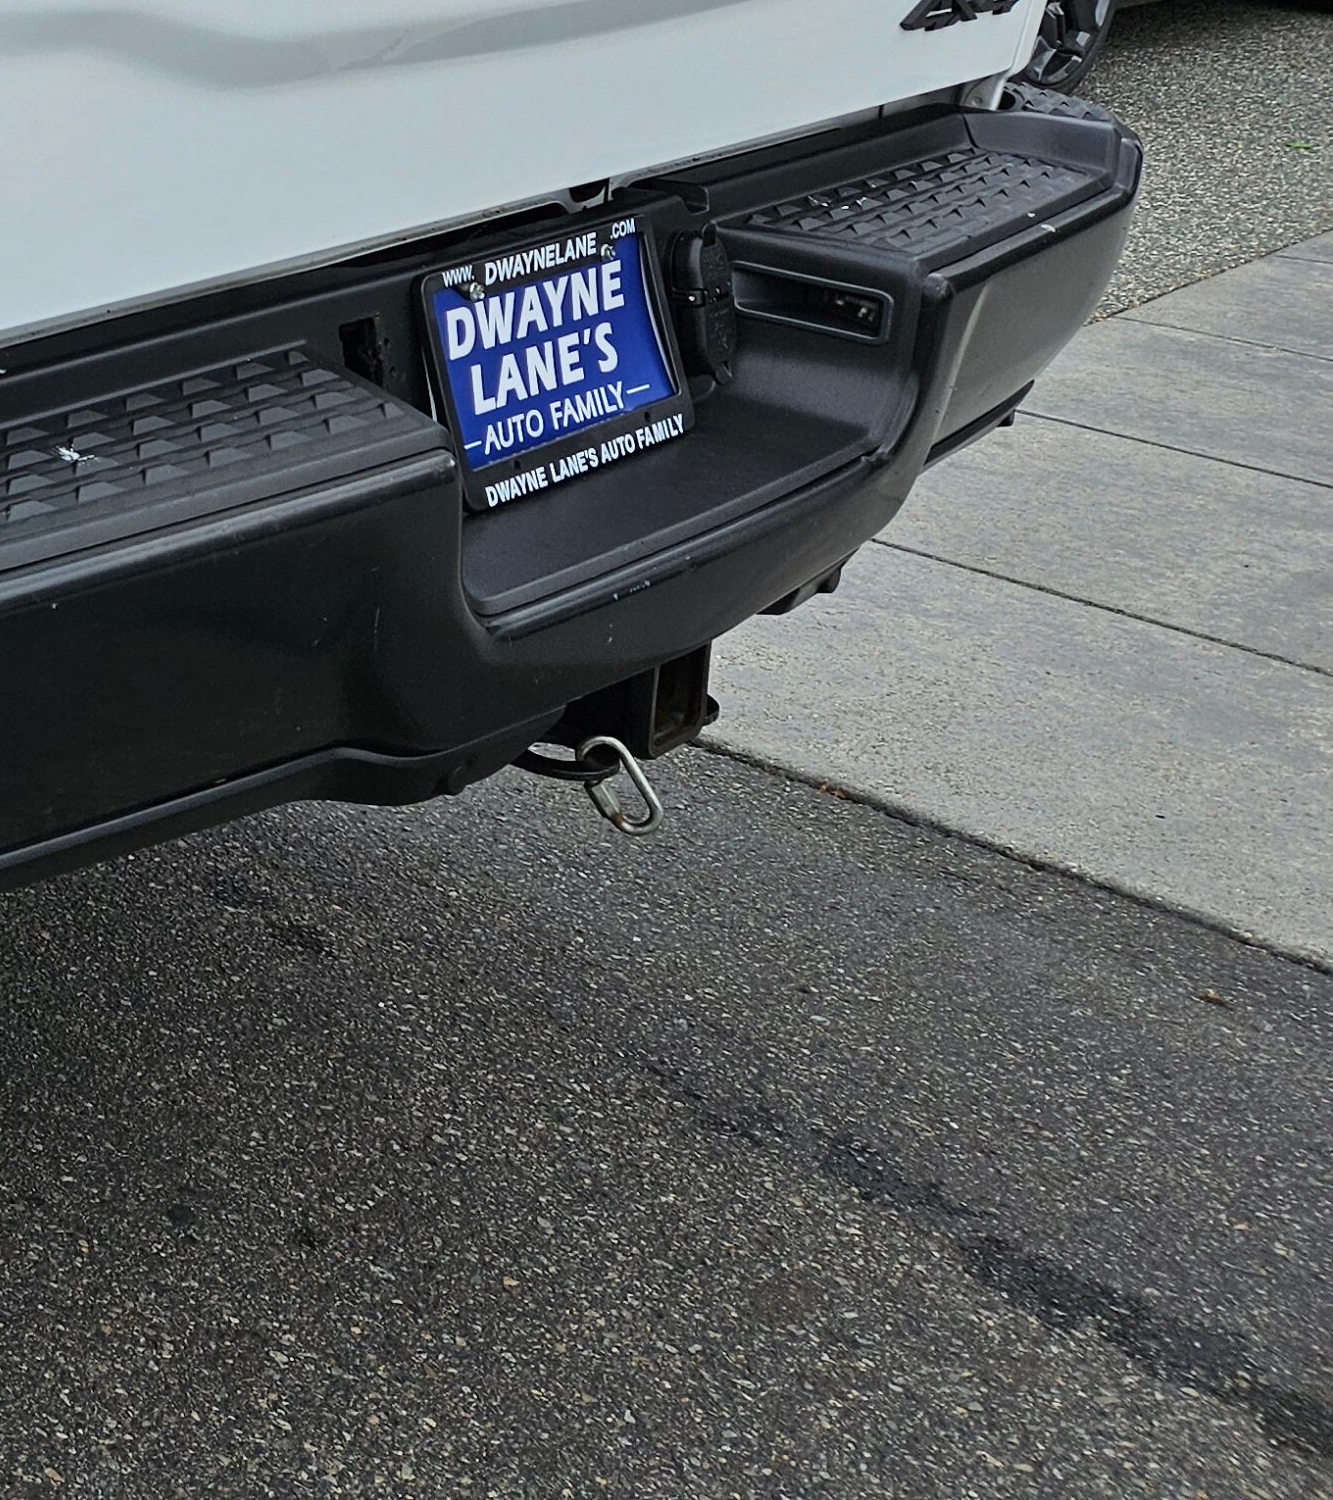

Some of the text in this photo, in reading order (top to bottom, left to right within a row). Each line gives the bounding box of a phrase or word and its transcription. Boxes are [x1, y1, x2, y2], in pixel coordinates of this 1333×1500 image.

[484, 231, 597, 287] DWAYNELANE
[609, 217, 636, 241] .COM
[445, 259, 626, 361] DWAYNE
[470, 321, 619, 416] LANE'S
[484, 380, 627, 456] AUTO FAMILY
[484, 413, 685, 508] DWAYNE LANE'S AUTO FAMILY
